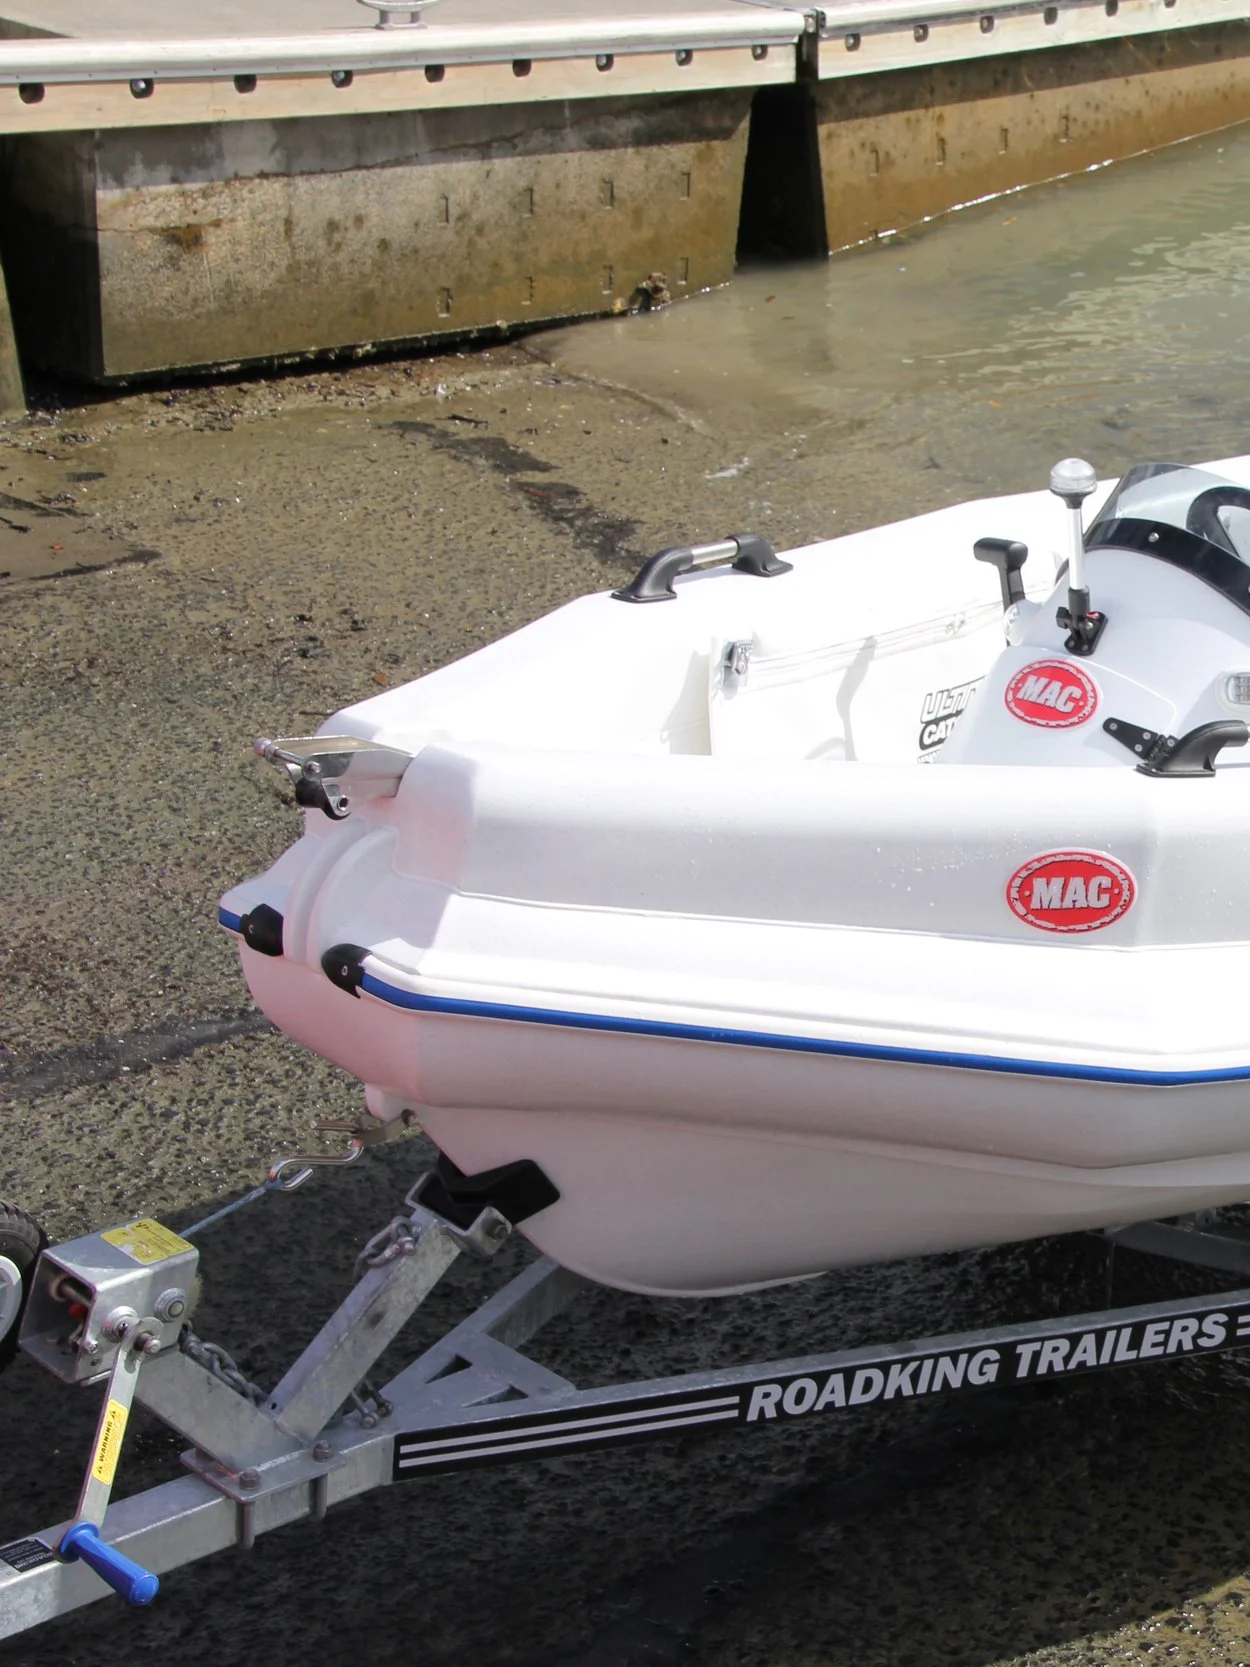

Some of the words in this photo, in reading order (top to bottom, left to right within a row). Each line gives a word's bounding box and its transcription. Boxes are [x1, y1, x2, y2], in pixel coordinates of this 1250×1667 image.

[1015, 674, 1083, 714] MAC
[1030, 875, 1113, 910] MAC
[746, 1348, 1001, 1422] ROADKING
[1015, 1313, 1228, 1378] TRAILERS
[98, 1421, 113, 1462] WARNING
